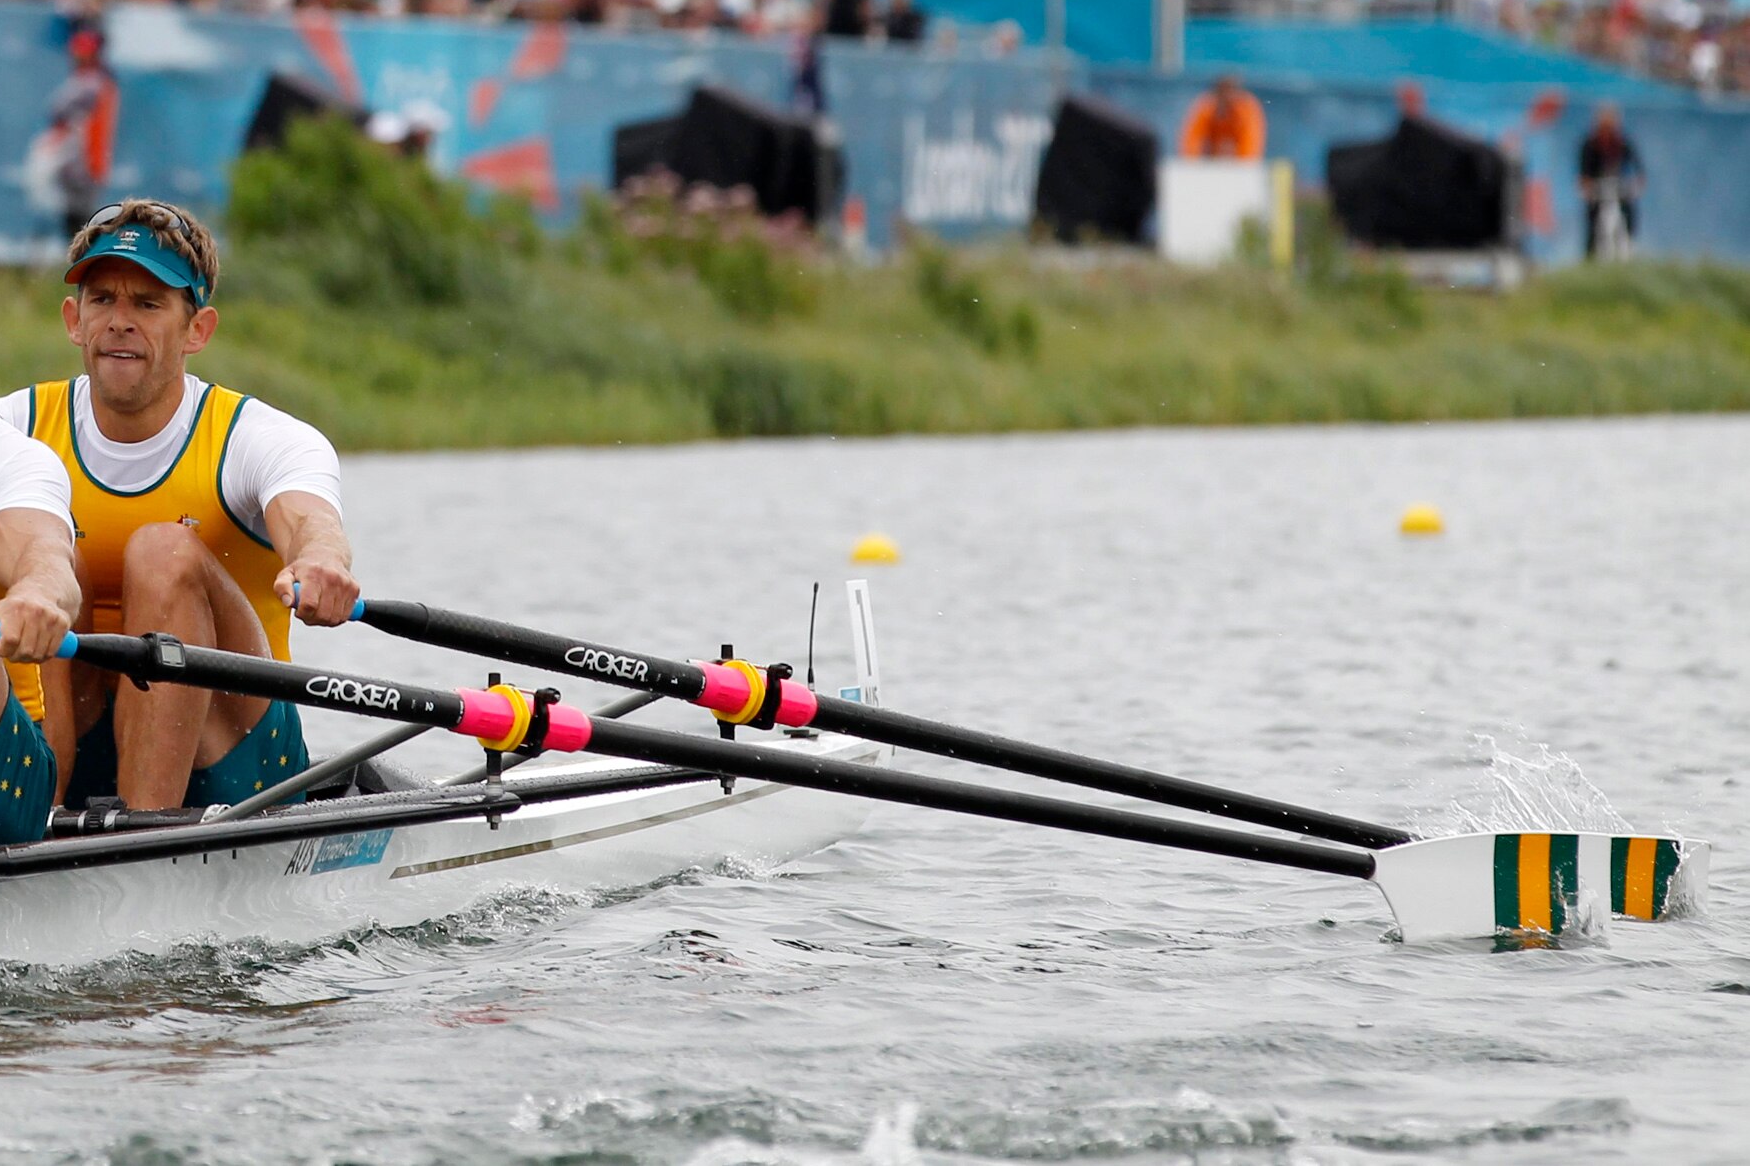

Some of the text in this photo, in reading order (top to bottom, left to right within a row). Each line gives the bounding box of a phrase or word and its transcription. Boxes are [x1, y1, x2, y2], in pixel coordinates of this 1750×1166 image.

[564, 646, 649, 682] CROKER
[306, 676, 401, 711] CROKER
[284, 836, 319, 876] AUS
